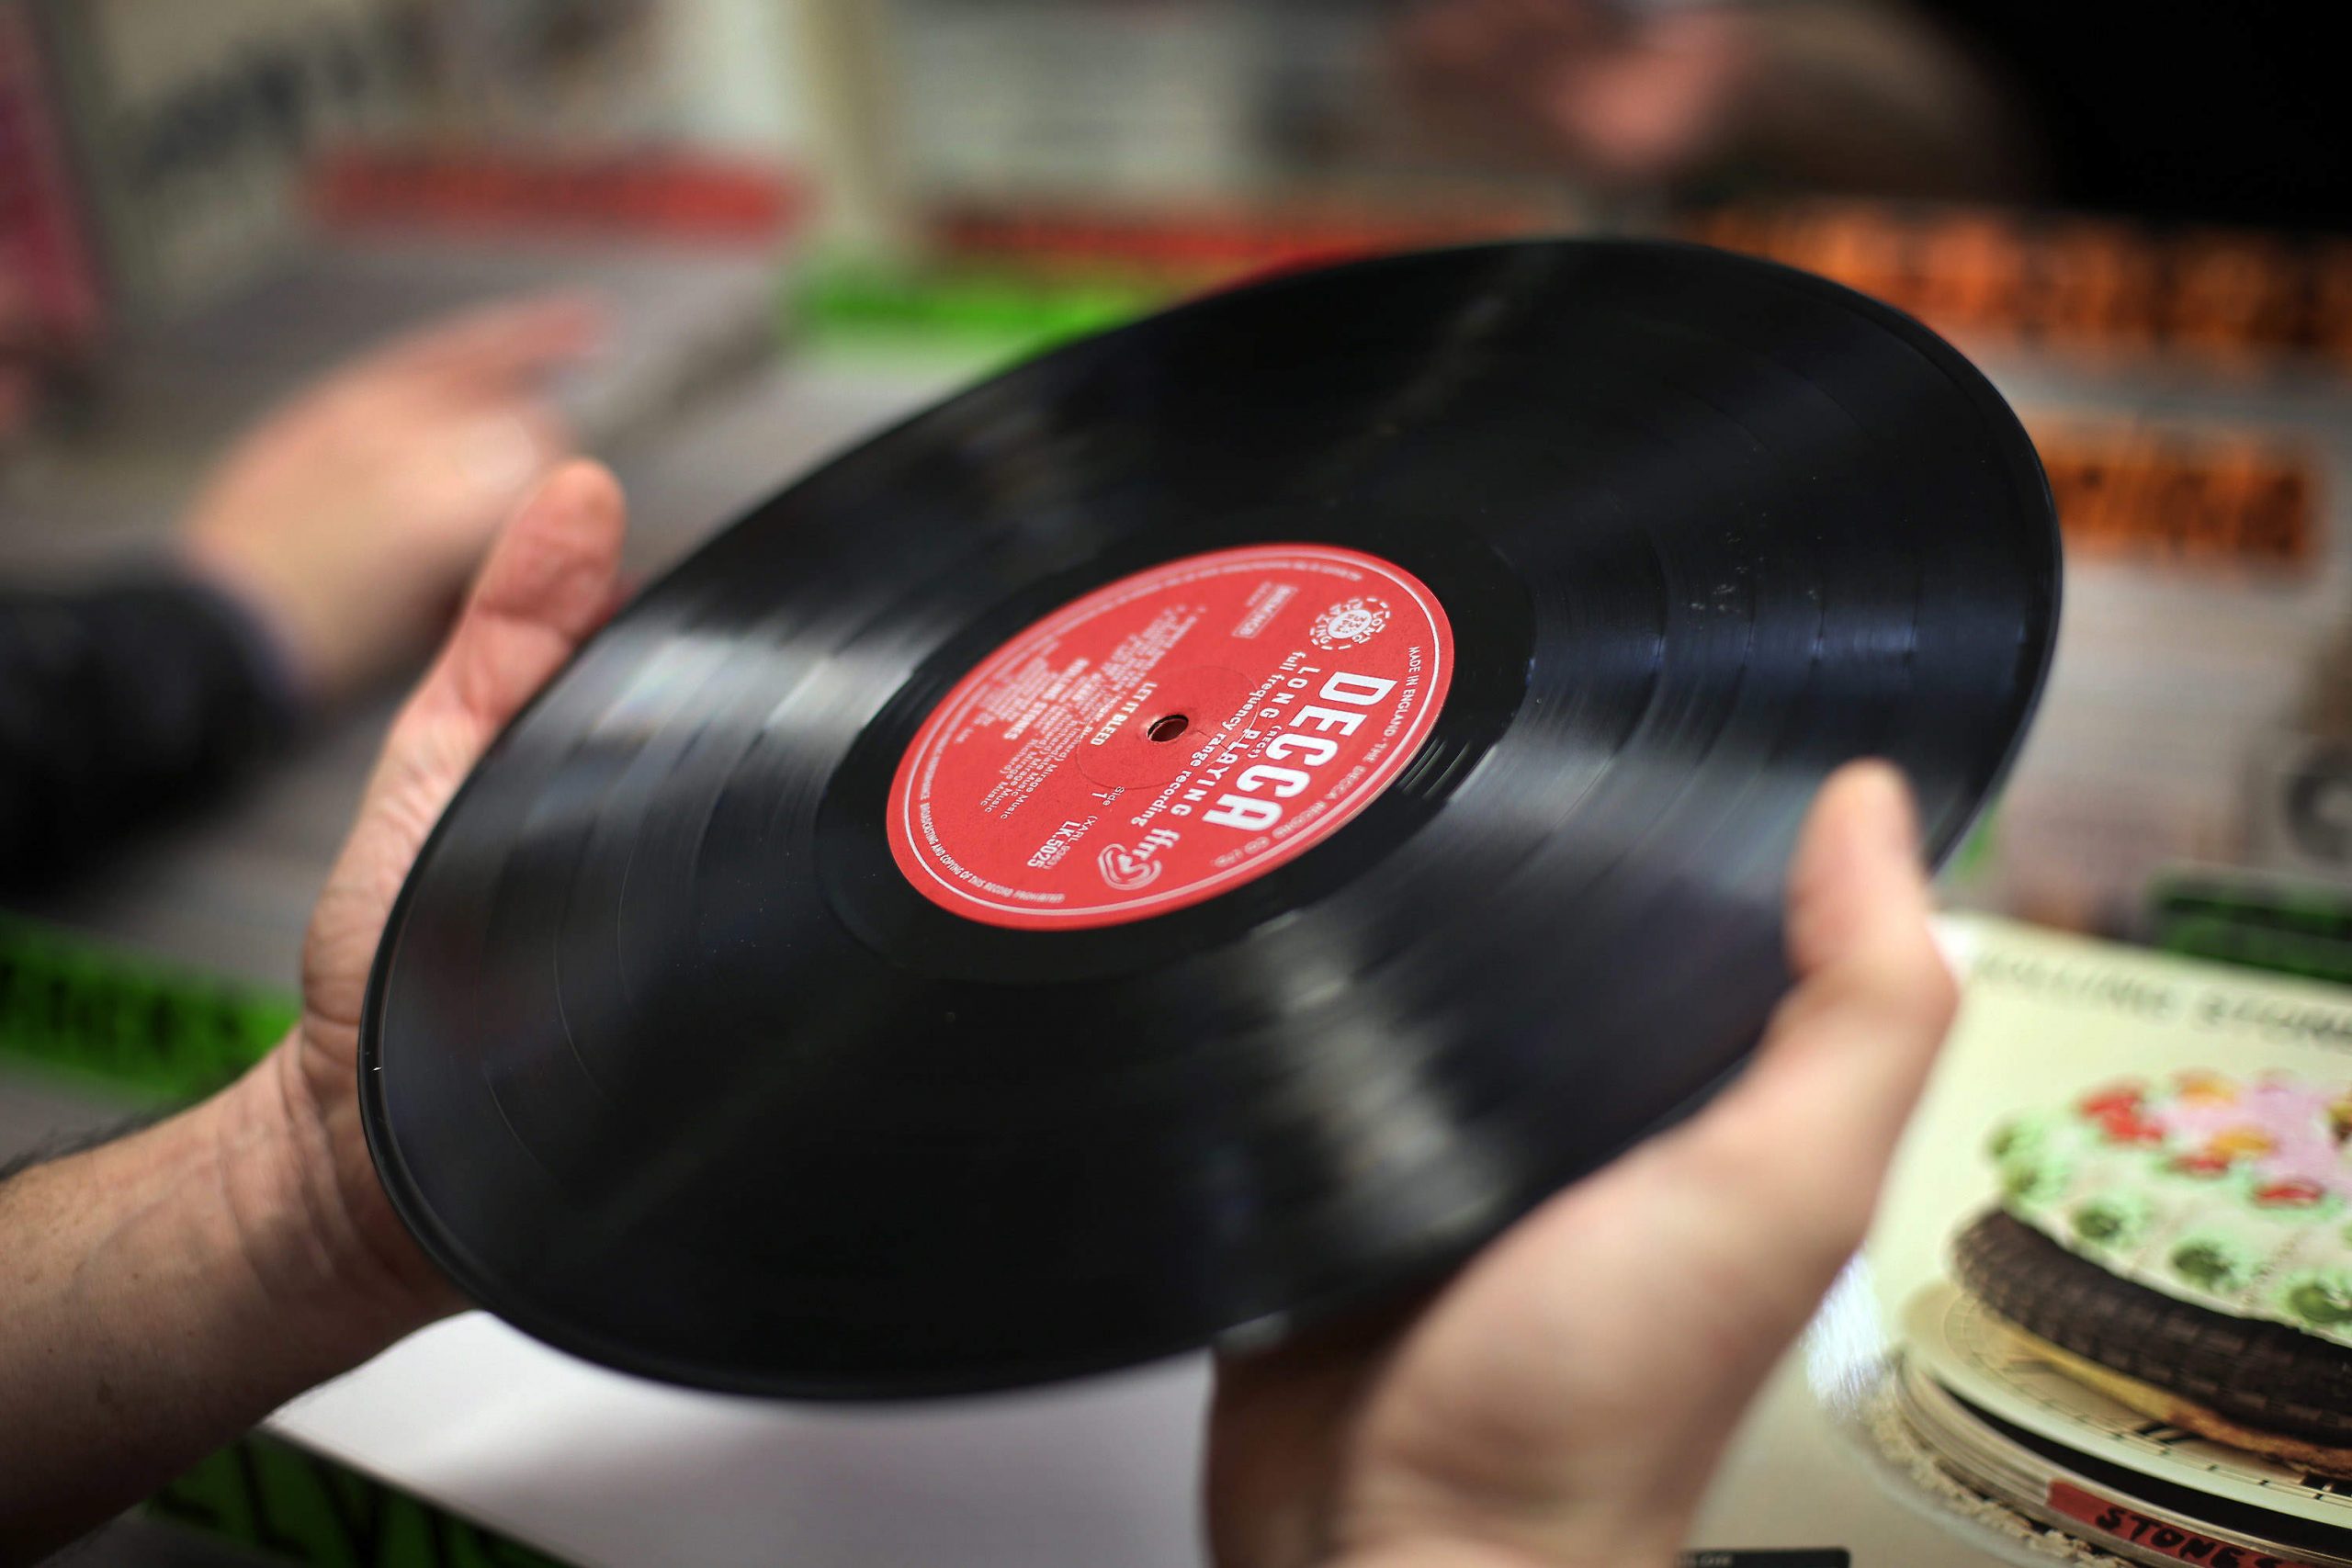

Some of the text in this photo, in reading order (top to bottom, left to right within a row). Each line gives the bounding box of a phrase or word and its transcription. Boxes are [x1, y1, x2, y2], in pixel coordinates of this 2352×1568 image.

[1408, 646, 1422, 673] MADE
[1132, 682, 1158, 702] LET
[1254, 666, 1321, 718] LONG
[1405, 674, 1419, 686] IN
[1121, 701, 1139, 714] IT
[1383, 688, 1416, 738] ENGLAND
[1090, 713, 1128, 746] BLEED
[1130, 651, 1306, 828] full frequency range recording
[1202, 671, 1398, 831] DECCA
[1170, 728, 1261, 817] PLAYING
[1102, 785, 1125, 807] Side
[1026, 820, 1081, 868] LK.5025
